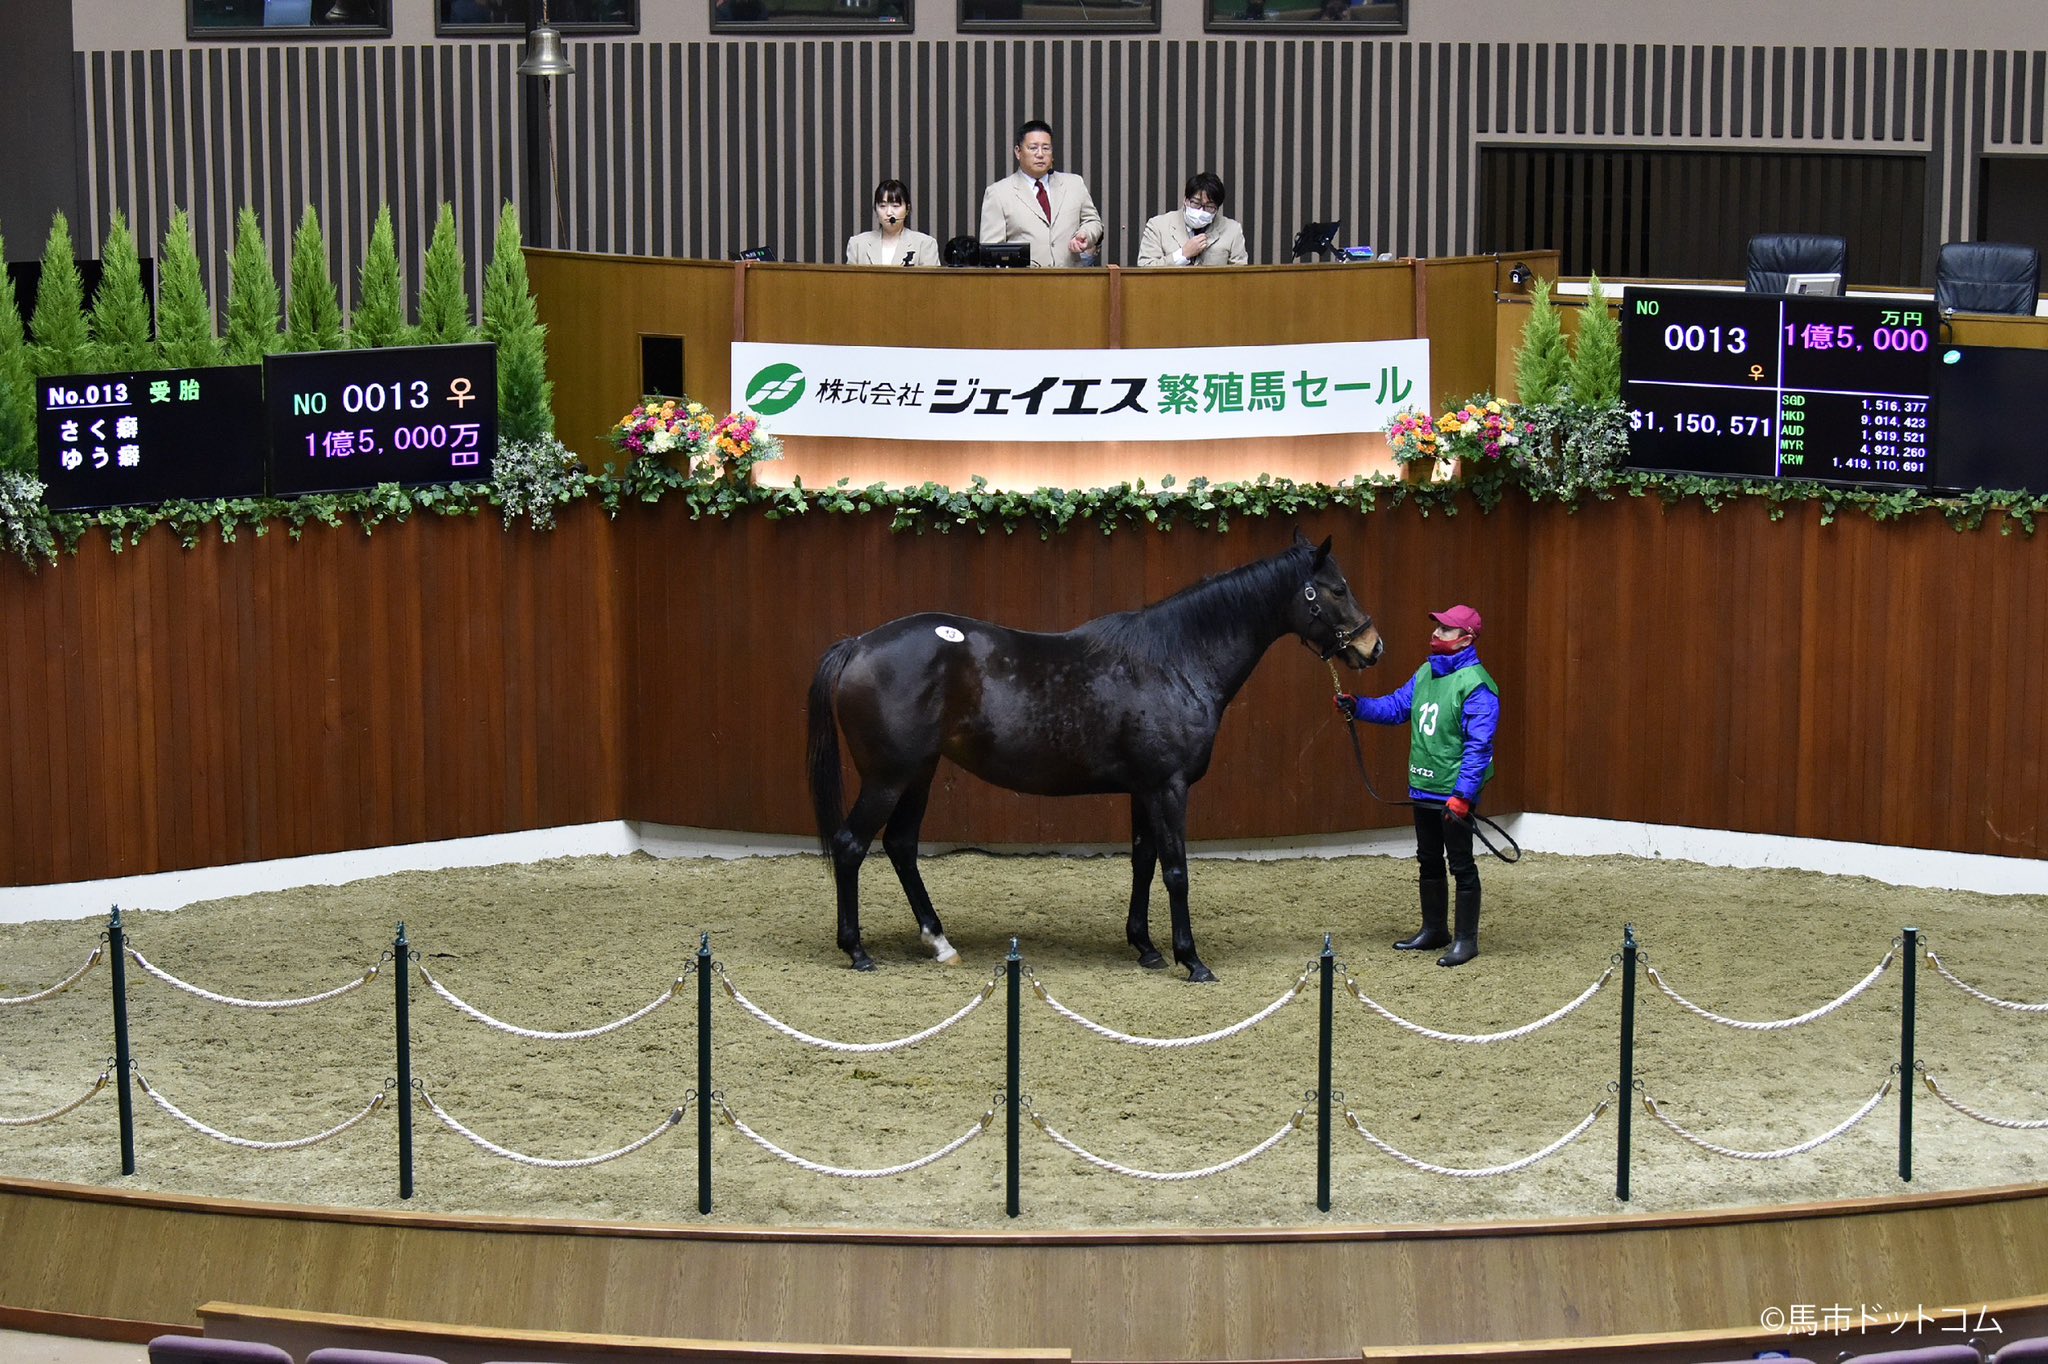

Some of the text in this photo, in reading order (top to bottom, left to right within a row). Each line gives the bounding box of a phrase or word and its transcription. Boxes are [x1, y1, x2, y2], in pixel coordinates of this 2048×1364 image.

[1636, 300, 1659, 315] NO
[1881, 310, 1922, 326] 万円
[1664, 324, 1747, 354] 0013
[48, 383, 128, 406] No.013
[293, 380, 429, 416] NO 0013
[1781, 395, 1806, 406] SGD
[1629, 409, 1770, 437] $1,150,571
[1781, 411, 1805, 421] HKD
[1780, 425, 1805, 436] AUD
[1779, 439, 1804, 450] MYR
[1779, 454, 1804, 465] KRW
[1418, 702, 1439, 736] 13
